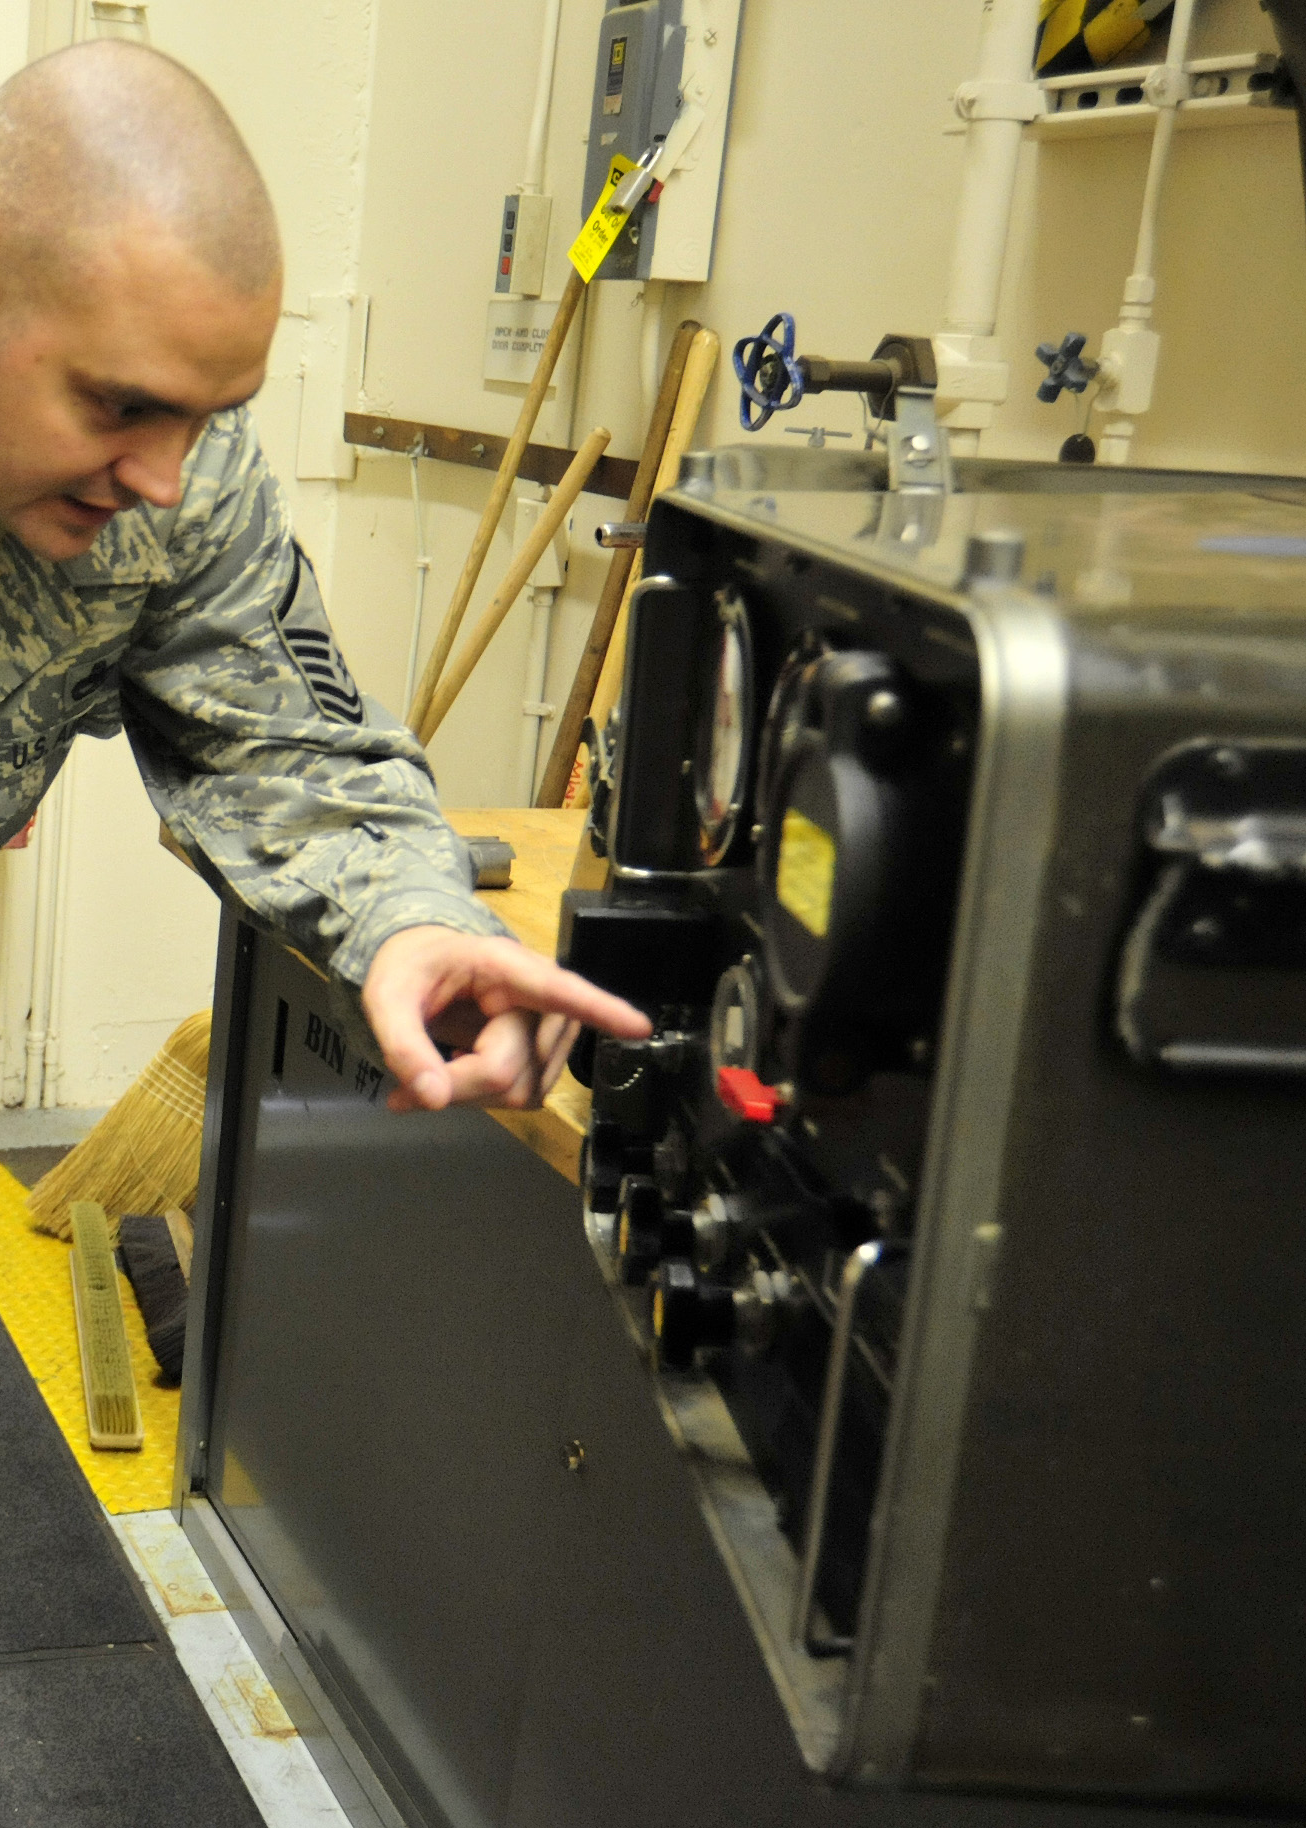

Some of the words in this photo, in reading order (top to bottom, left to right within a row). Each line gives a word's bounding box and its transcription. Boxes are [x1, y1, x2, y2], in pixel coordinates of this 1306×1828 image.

[592, 220, 609, 243] Order
[495, 327, 512, 337] OPEN
[515, 328, 529, 337] AND
[532, 329, 551, 339] CLOS
[492, 340, 509, 350] DOOR
[512, 342, 545, 353] COMPLET
[304, 1010, 347, 1077] BIN
